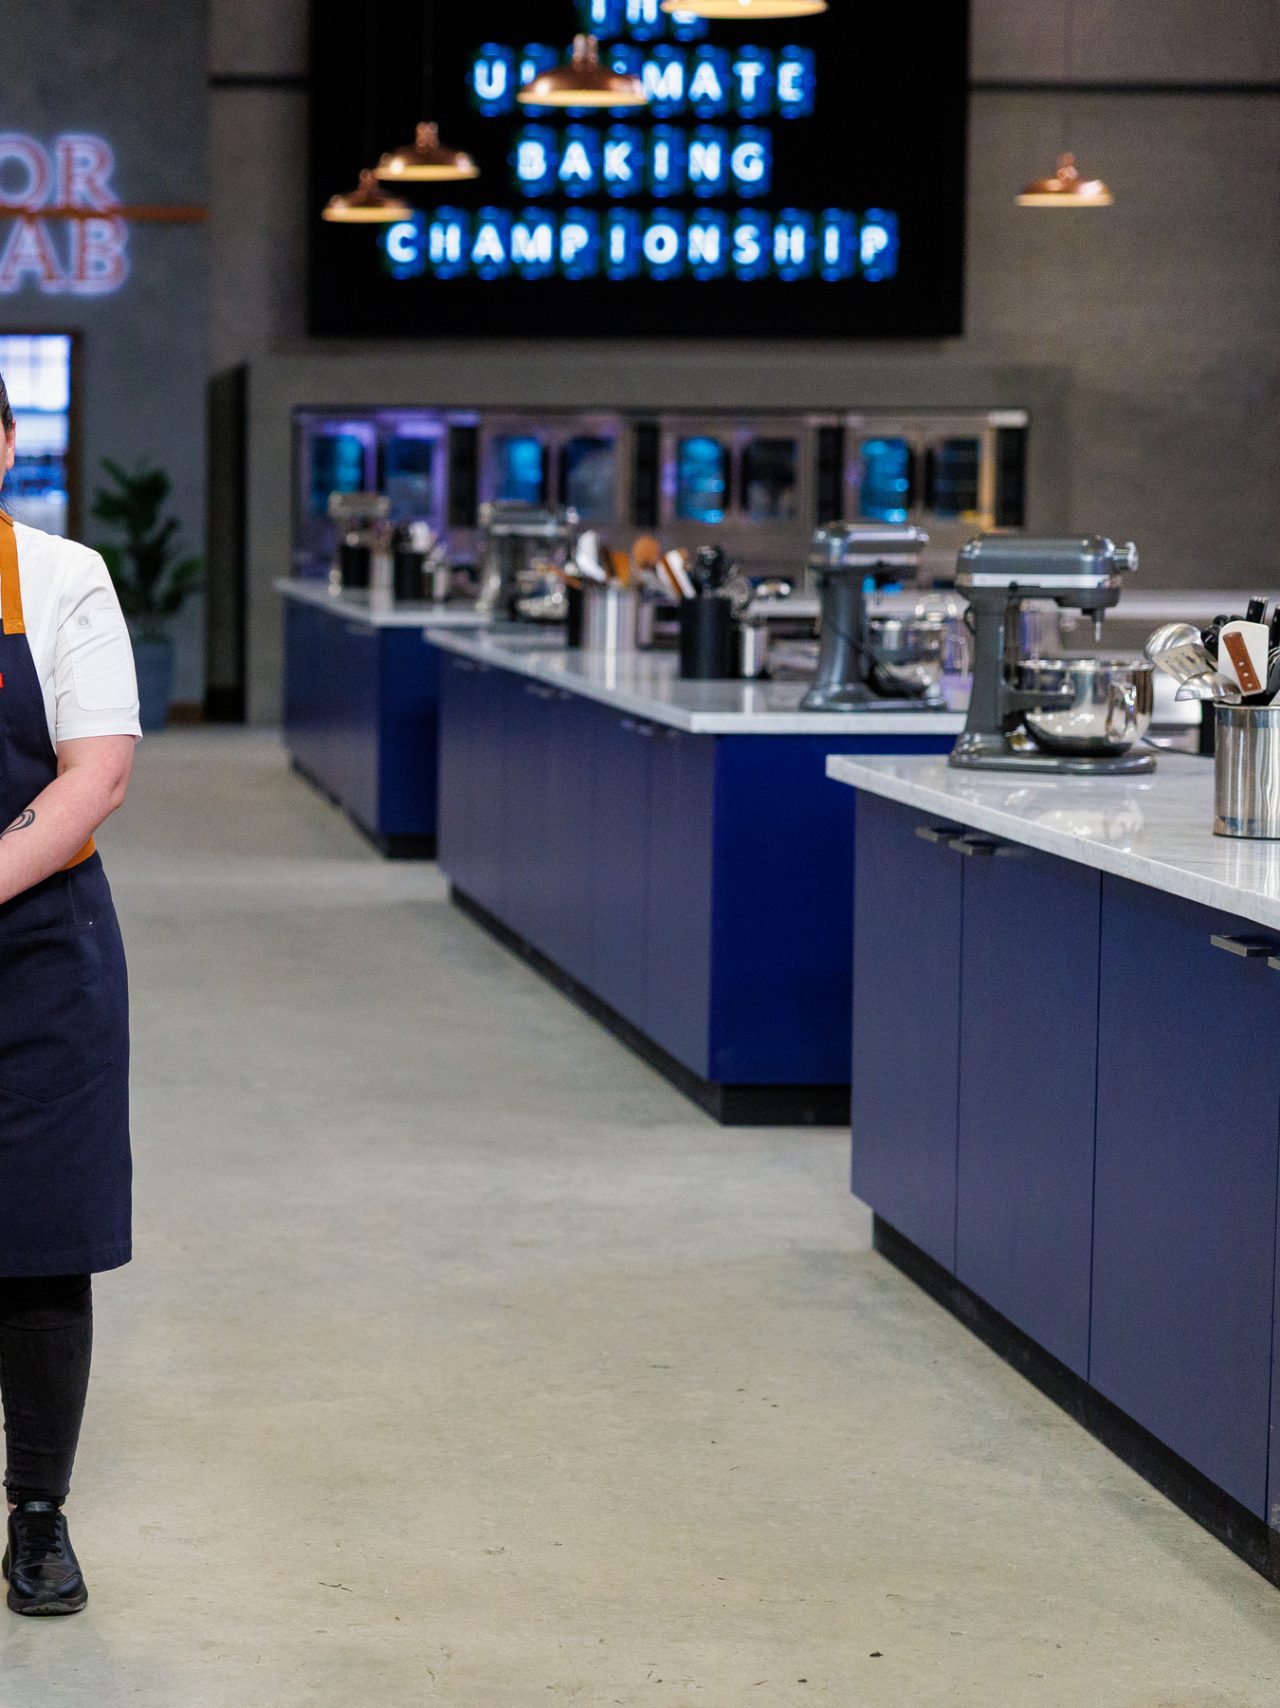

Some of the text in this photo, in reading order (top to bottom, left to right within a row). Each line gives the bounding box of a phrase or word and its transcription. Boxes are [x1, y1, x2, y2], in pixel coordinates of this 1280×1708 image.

[474, 60, 804, 101] UMATE
[517, 140, 765, 181] BAKING
[386, 224, 888, 264] CHAMPIONSHIP
